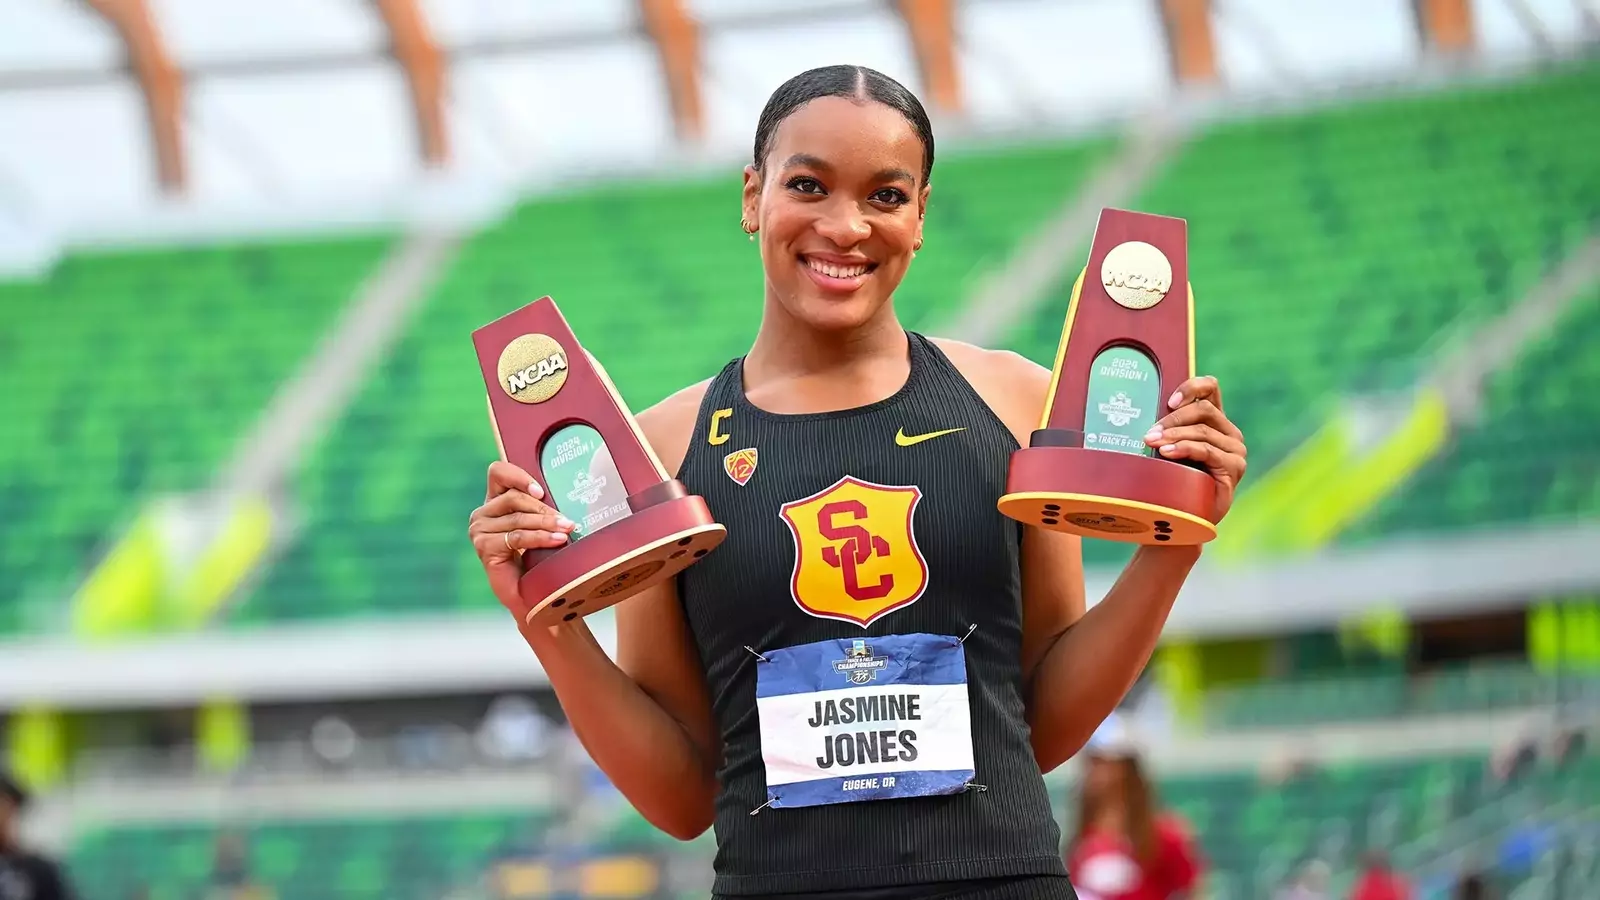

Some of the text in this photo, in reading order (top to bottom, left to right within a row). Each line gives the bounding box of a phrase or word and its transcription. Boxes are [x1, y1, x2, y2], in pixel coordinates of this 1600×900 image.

[507, 353, 567, 394] NCAA
[1100, 366, 1143, 381] DIVISION
[1112, 358, 1138, 370] 2024
[708, 407, 733, 446] C
[556, 436, 581, 456] 2024
[1098, 434, 1122, 446] TRACK
[1126, 437, 1146, 449] FIELD
[550, 445, 589, 469] DIVISION
[582, 511, 604, 529] TRACK
[817, 500, 894, 601] SC
[838, 660, 883, 670] CHAMPIONSHIPS
[808, 694, 921, 728] JASMINE
[816, 729, 918, 769] JONES
[843, 777, 896, 791] EUGENE, OR
